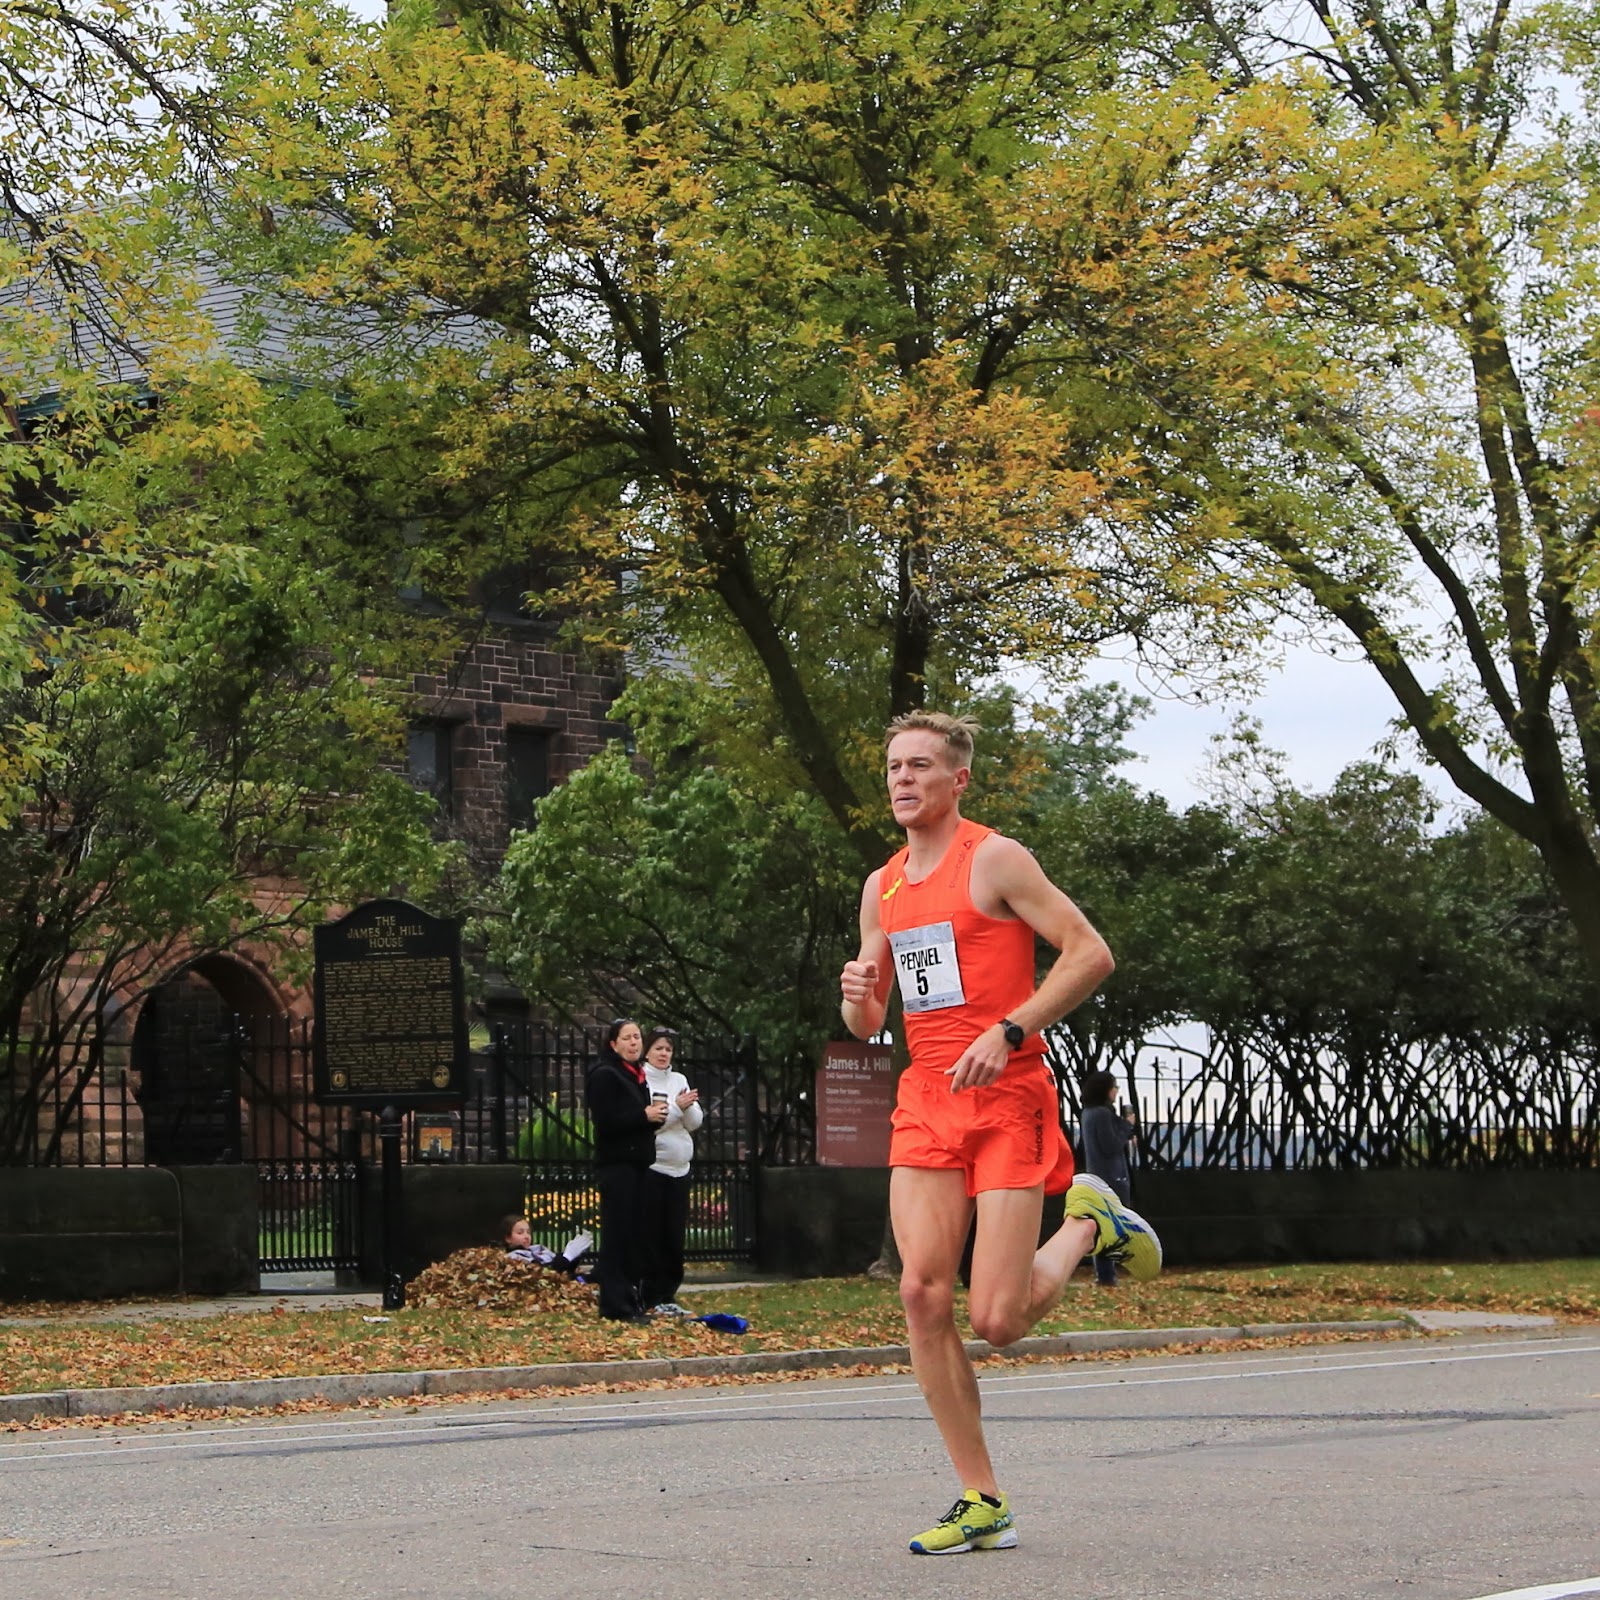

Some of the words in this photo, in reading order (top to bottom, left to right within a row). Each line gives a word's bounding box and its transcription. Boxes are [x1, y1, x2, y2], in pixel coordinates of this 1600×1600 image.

[375, 915, 397, 926] THE
[347, 926, 381, 939] JAMES
[386, 926, 395, 937] J.
[399, 925, 425, 936] HILL
[369, 937, 404, 949] HOUSE
[900, 947, 943, 972] PENNEL
[915, 968, 929, 996] 5
[825, 1056, 859, 1071] James
[862, 1057, 871, 1071] J.
[873, 1057, 891, 1072] Hill
[1034, 1124, 1044, 1165] Reebok
